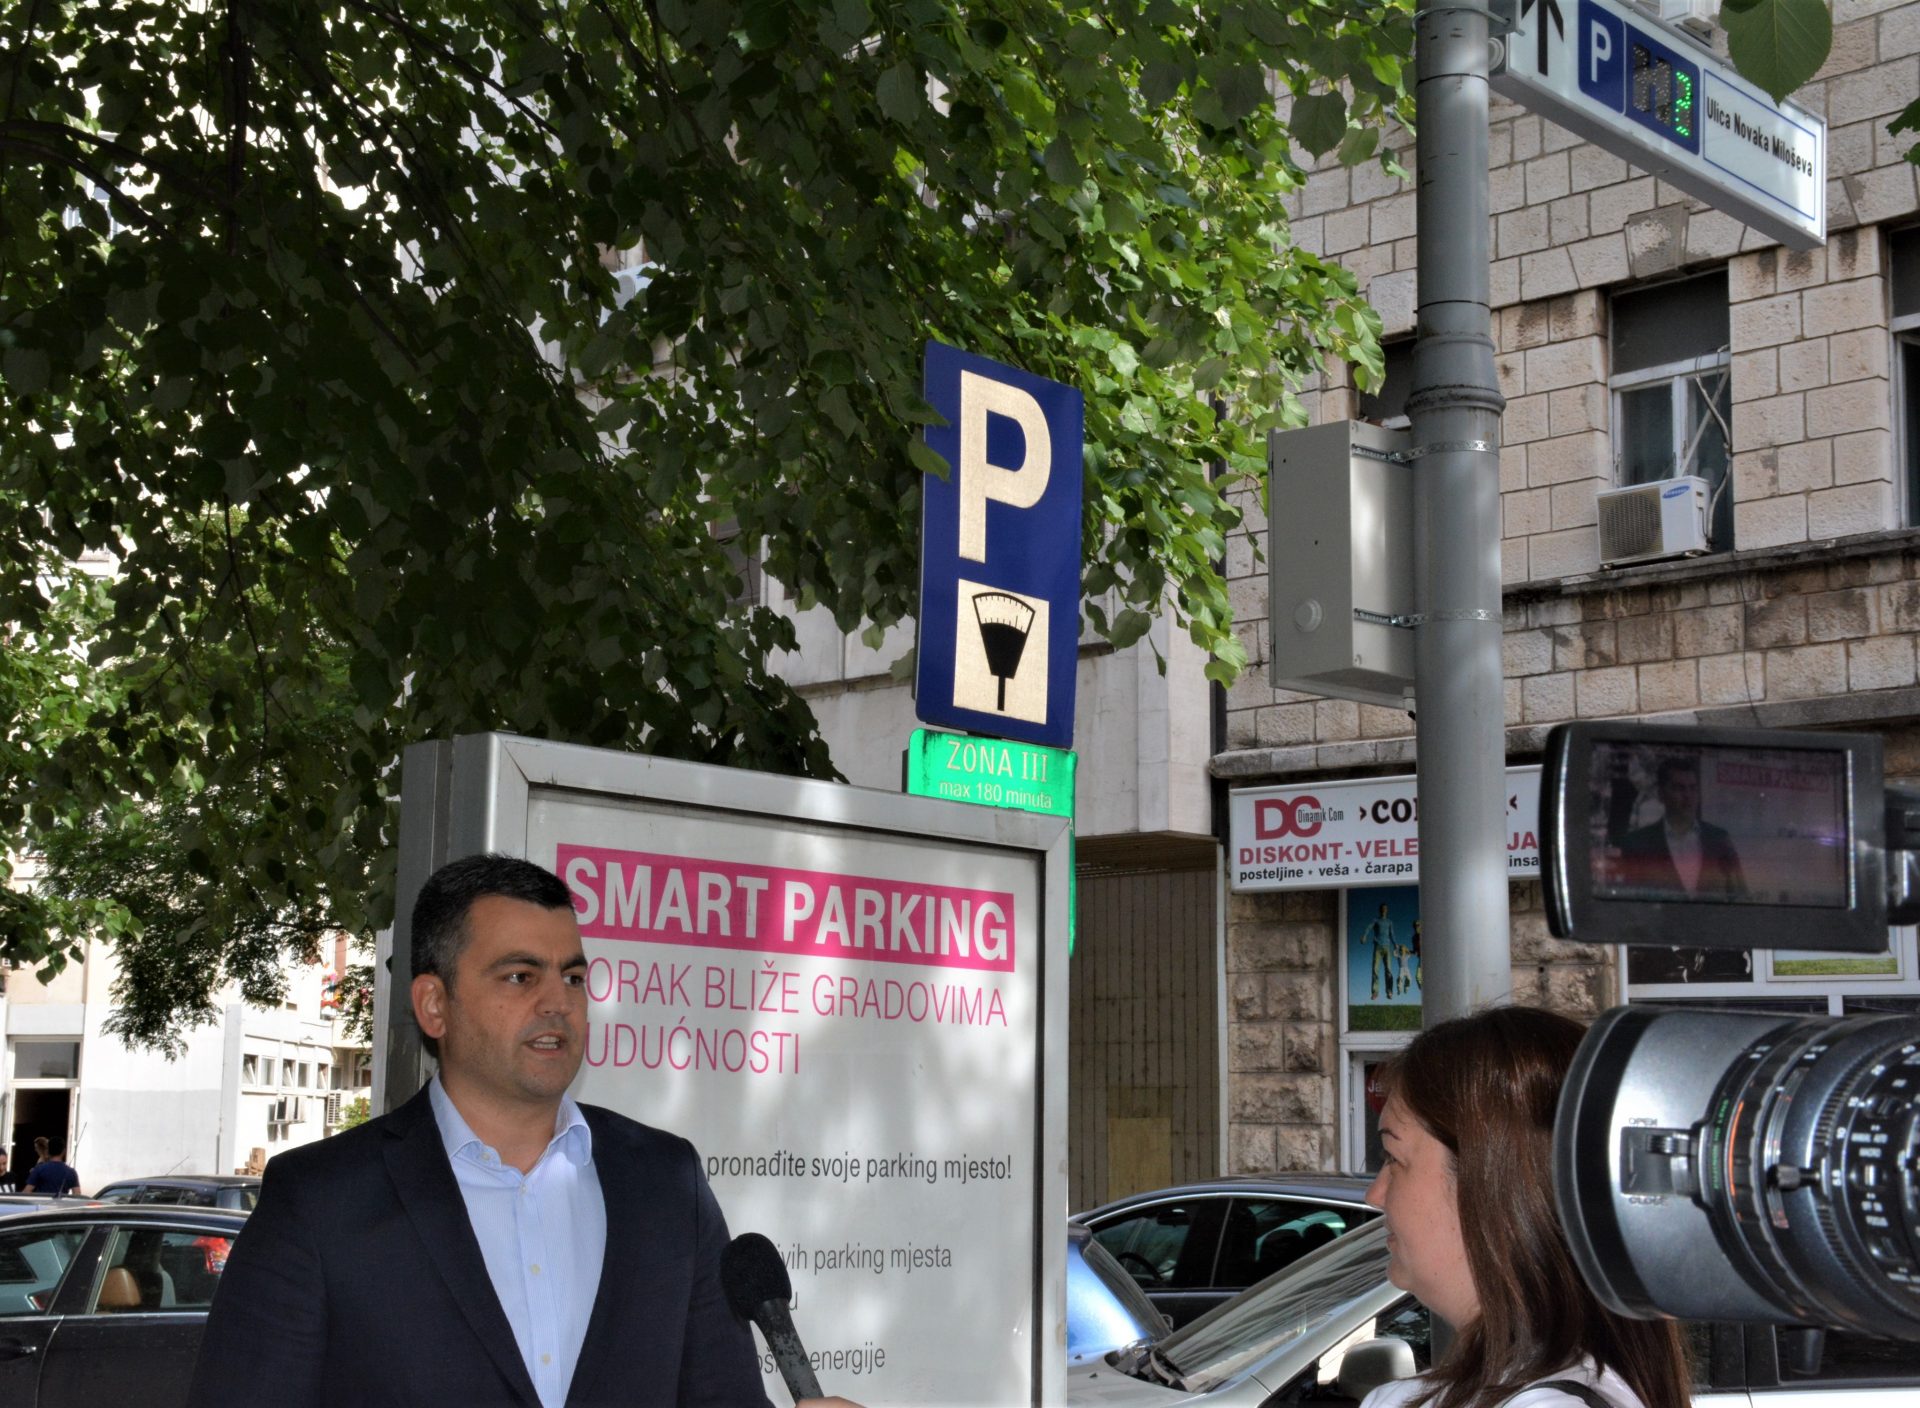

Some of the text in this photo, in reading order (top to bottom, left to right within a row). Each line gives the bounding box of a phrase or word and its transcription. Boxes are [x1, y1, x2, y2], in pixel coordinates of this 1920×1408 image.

[1591, 19, 1612, 83] P
[1707, 96, 1813, 177] Ulica Novaka Miloševa
[959, 369, 1052, 563] P
[946, 740, 1048, 783] ZONA III
[939, 780, 1052, 809] max 180 minuta
[1255, 795, 1323, 840] DC
[1507, 831, 1538, 851] JA
[1240, 854, 1539, 883] posteljine veša čarapa insa
[563, 856, 1008, 961] SMART PARKING
[585, 956, 1008, 1028] ORAK BLIŽE GRADOVIMA
[585, 1015, 800, 1075] UDUĆNOSTI
[707, 1150, 1013, 1185] pronađite svoje parking mjesto!
[814, 1242, 885, 1276] parking
[890, 1241, 952, 1274] mjesta
[810, 1341, 886, 1375] energije
